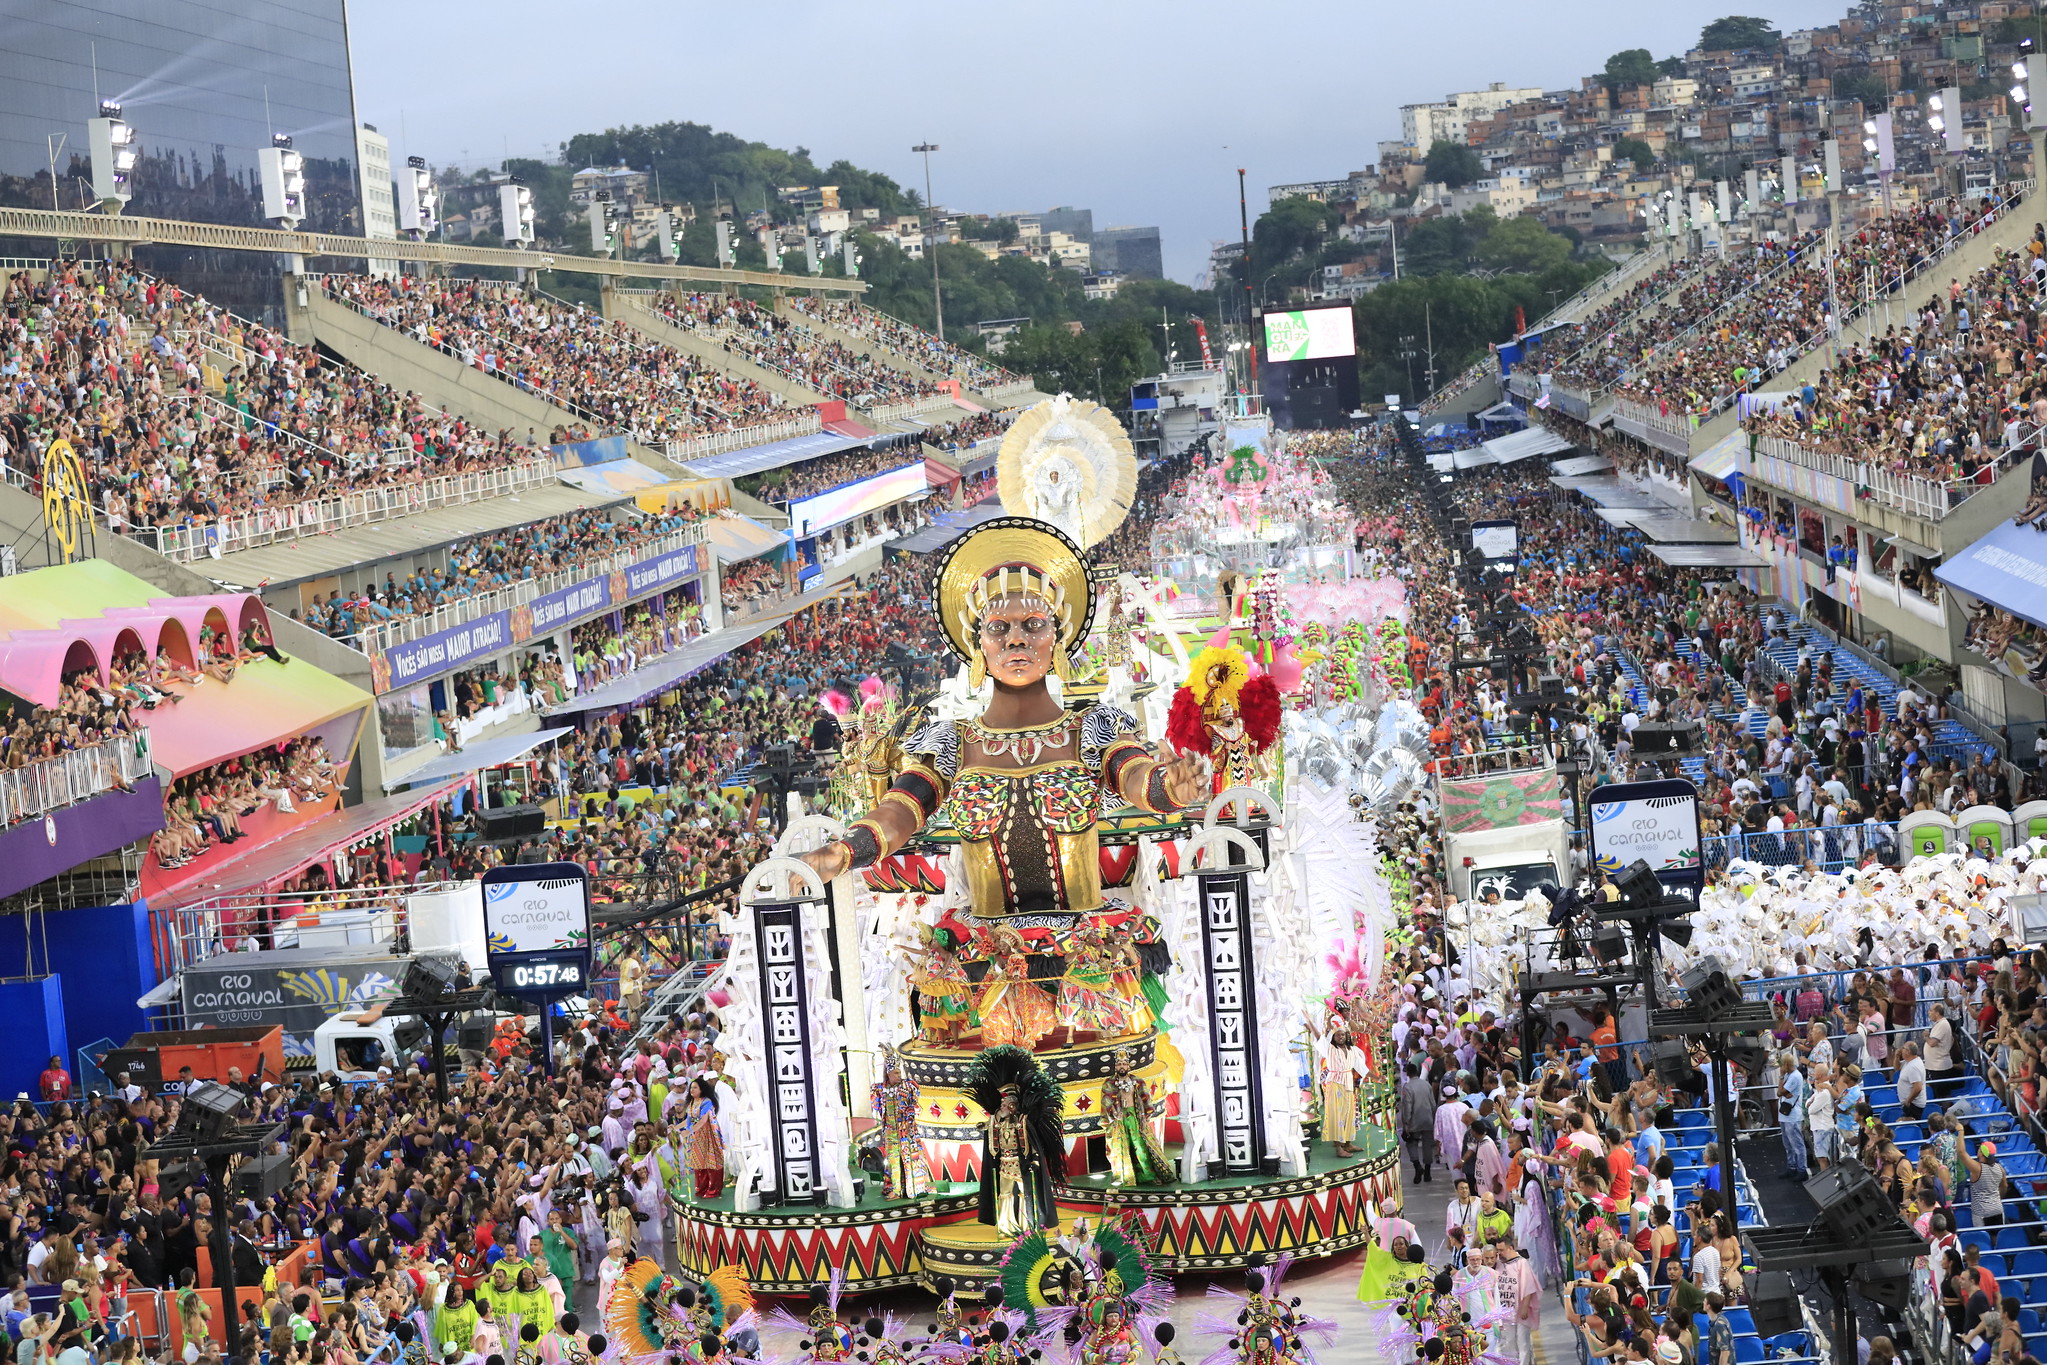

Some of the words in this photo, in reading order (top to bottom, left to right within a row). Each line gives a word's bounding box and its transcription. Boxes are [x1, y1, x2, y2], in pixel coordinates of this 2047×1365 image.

[565, 590, 580, 615] MAIOR
[446, 630, 472, 662] MAIOR
[472, 618, 502, 649] ATRAÇÃO!
[1632, 818, 1657, 830] RIO
[523, 899, 548, 910] RIO
[220, 974, 252, 989] RIO
[514, 964, 579, 986] 0:57:48
